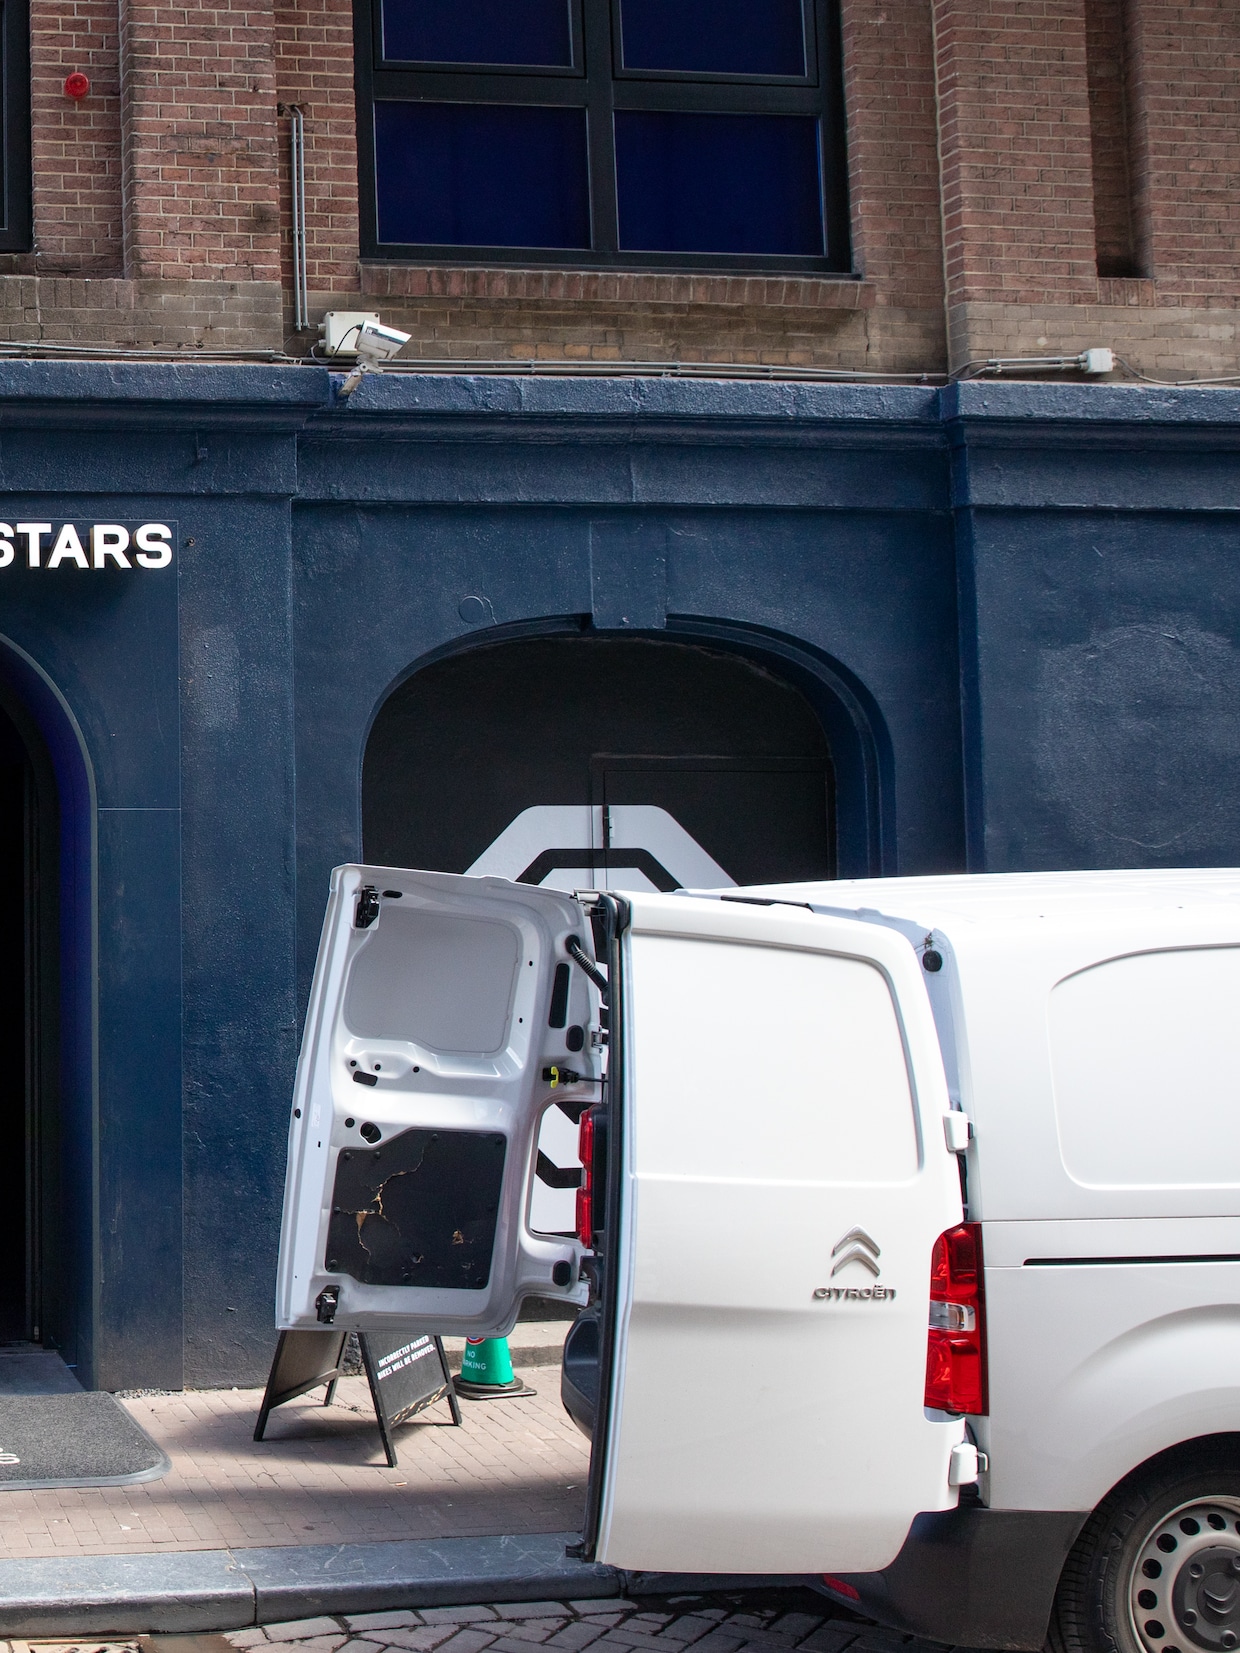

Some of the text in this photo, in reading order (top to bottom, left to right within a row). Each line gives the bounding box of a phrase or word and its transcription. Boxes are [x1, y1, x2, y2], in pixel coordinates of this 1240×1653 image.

[812, 1284, 897, 1301] CITROËN
[376, 1343, 436, 1381] BIKES WILL BE REMOVED.
[378, 1334, 430, 1368] INCORRECTLY PARKED
[466, 1350, 476, 1359] NO
